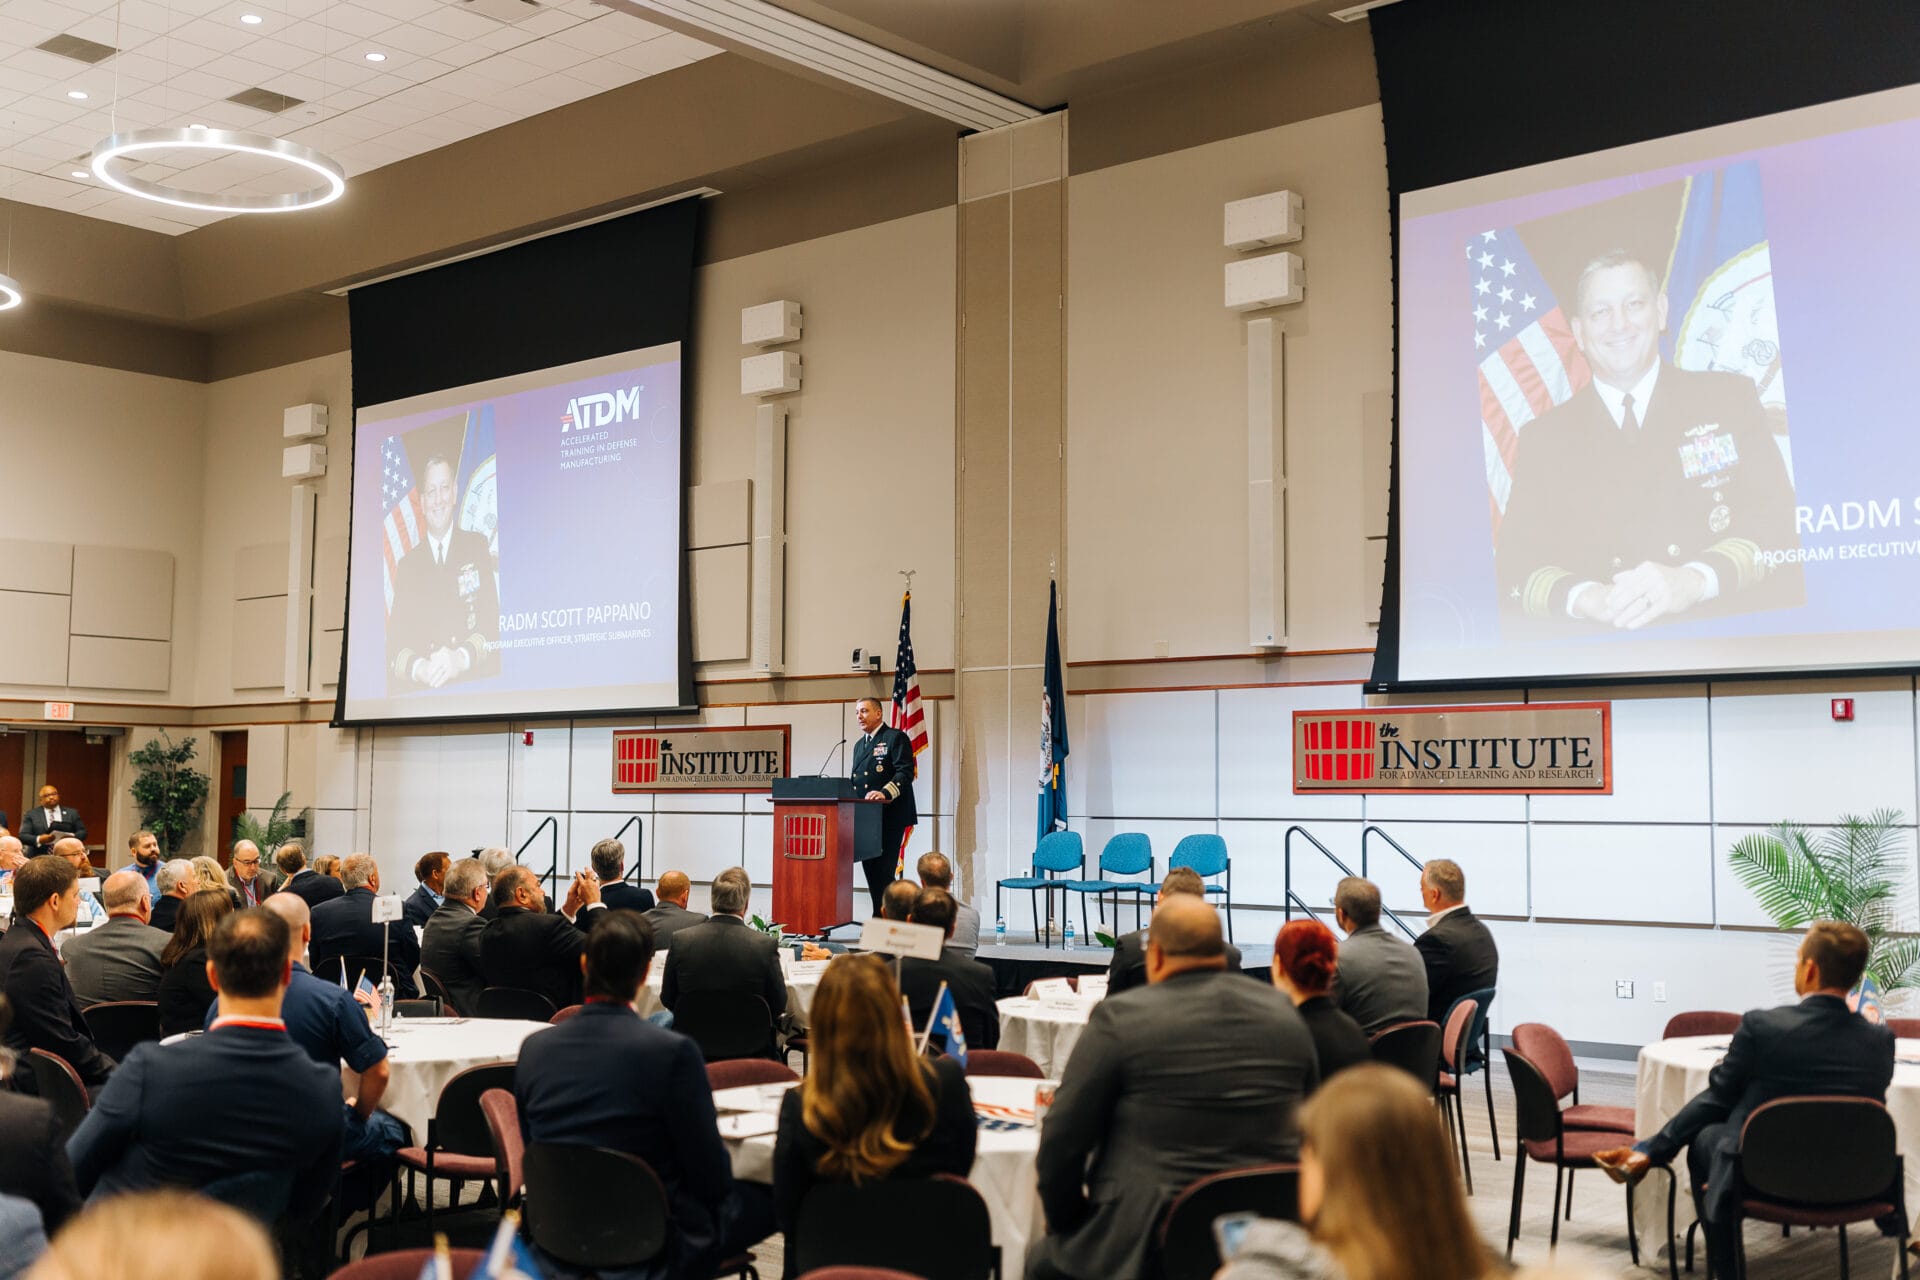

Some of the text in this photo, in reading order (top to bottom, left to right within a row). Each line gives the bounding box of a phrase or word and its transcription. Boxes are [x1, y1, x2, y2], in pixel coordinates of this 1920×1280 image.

[560, 385, 641, 433] ATDM
[560, 431, 609, 448] ACCELERATED
[560, 438, 638, 460] TRAINING IN DEFENSE
[560, 453, 622, 471] MANUFACTURING
[1795, 498, 1901, 534] RADM
[1754, 546, 1834, 566] PROGRAM
[498, 601, 652, 632] RADM SCOTT PAPPANO
[483, 628, 652, 651] PROGRAM EXECUTIVE OFFICER, STRATEGIC SUBMARINES
[51, 703, 69, 719] EXIT
[1379, 722, 1399, 738] the
[660, 750, 779, 775] INSTITUTE
[1380, 736, 1594, 771] INSTITUTE
[659, 775, 671, 783] FOR
[672, 775, 702, 783] ADVANCED
[703, 775, 733, 783] LEARNING
[1379, 769, 1594, 780] FOR ADVANCED LEARNING AND RESEARCH
